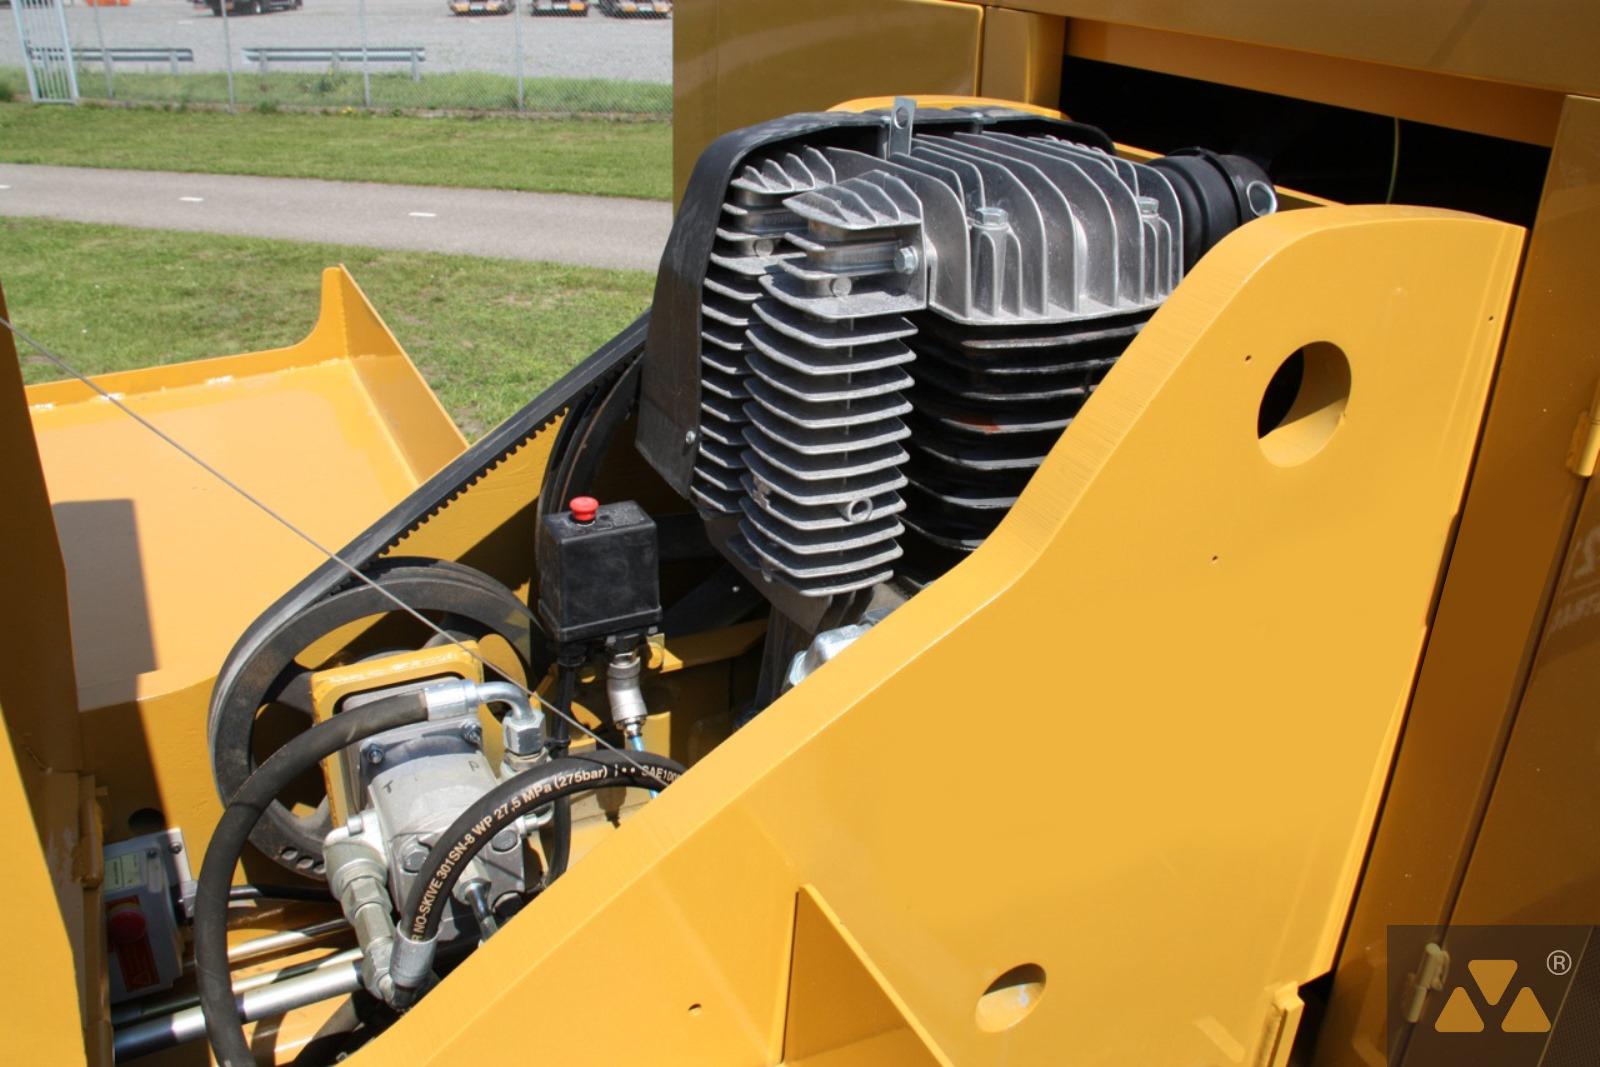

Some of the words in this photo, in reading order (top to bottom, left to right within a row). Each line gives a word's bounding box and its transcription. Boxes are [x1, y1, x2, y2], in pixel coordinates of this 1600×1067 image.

[413, 877, 444, 934] NO-SKIVE
[436, 833, 476, 880] 301SN-8
[471, 815, 494, 836] WP
[493, 796, 522, 820] 27,5
[521, 780, 553, 804] MPa
[552, 764, 608, 790] (275bar)
